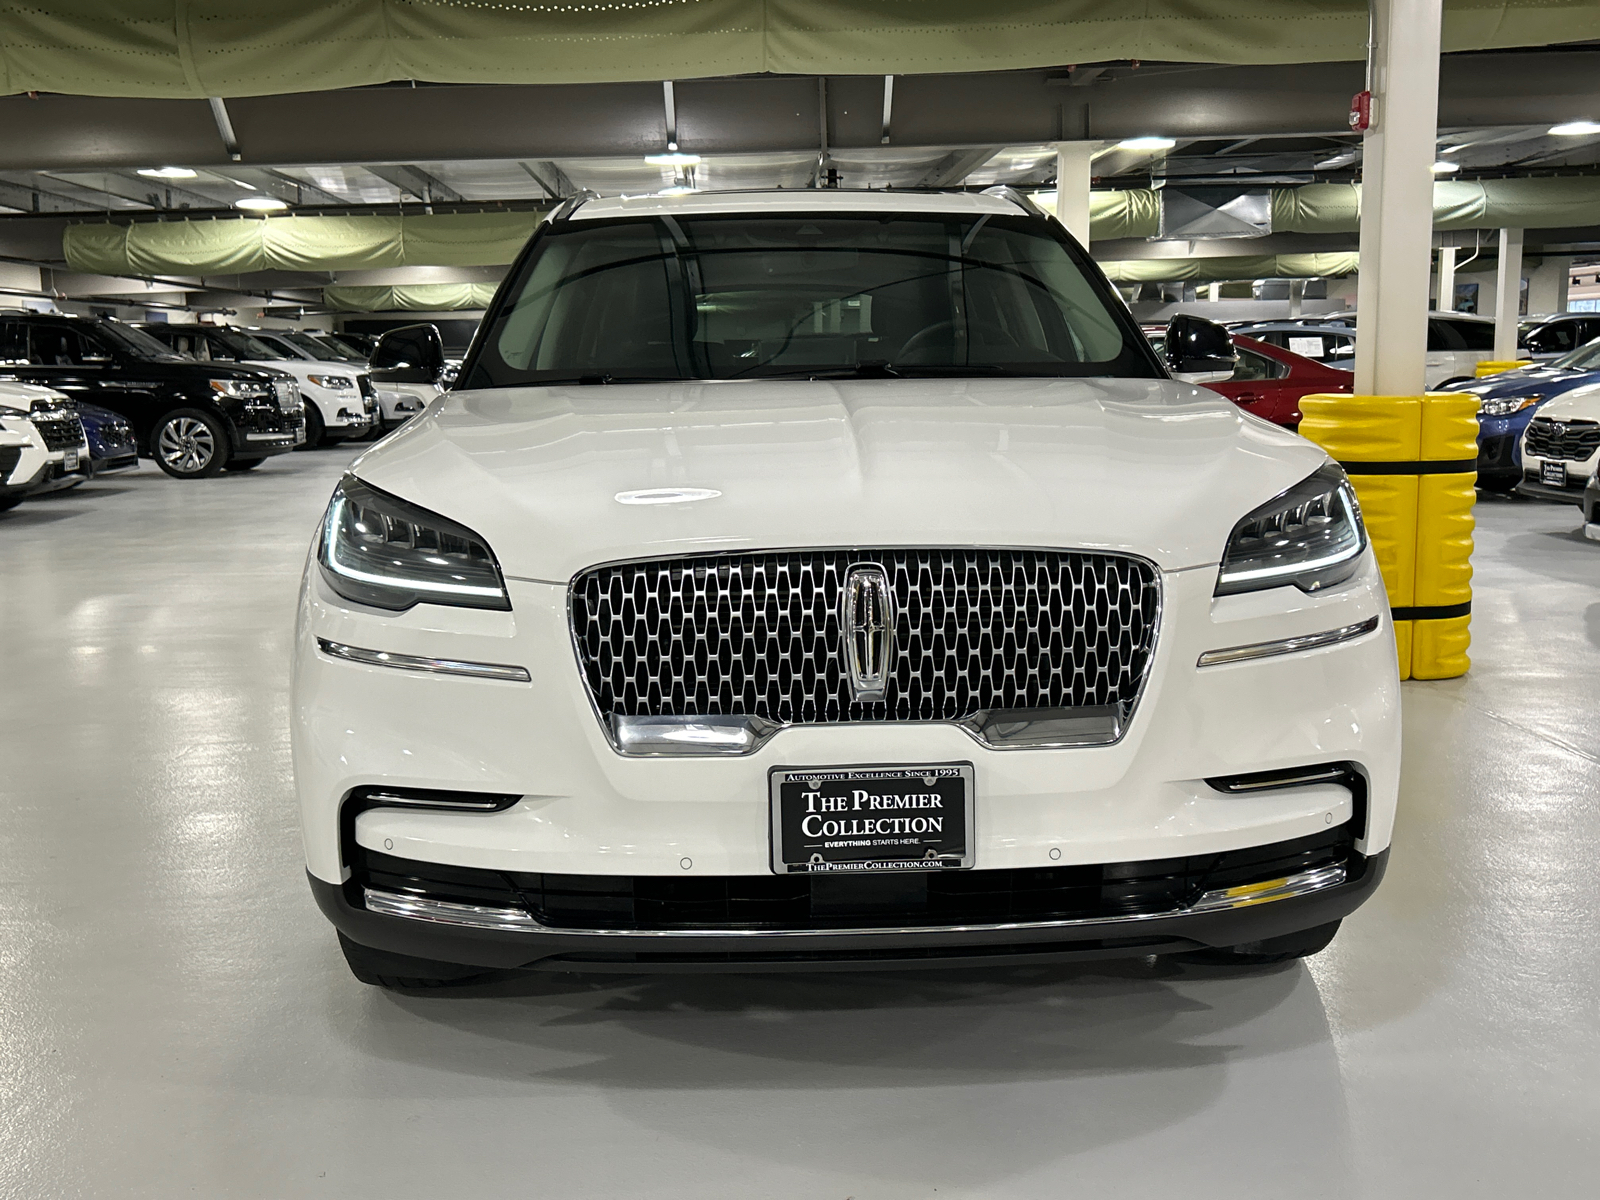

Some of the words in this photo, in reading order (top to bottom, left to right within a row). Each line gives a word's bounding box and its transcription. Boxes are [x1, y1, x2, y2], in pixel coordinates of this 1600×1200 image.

[904, 769, 932, 777] SINCE
[935, 768, 959, 776] 1995
[801, 791, 848, 813] THE
[851, 790, 944, 811] PREMIER
[801, 814, 944, 838] COLLECTION
[824, 840, 871, 848] EVERYTHING
[805, 861, 943, 872] THEPREMIERCOLLECTION.COM
